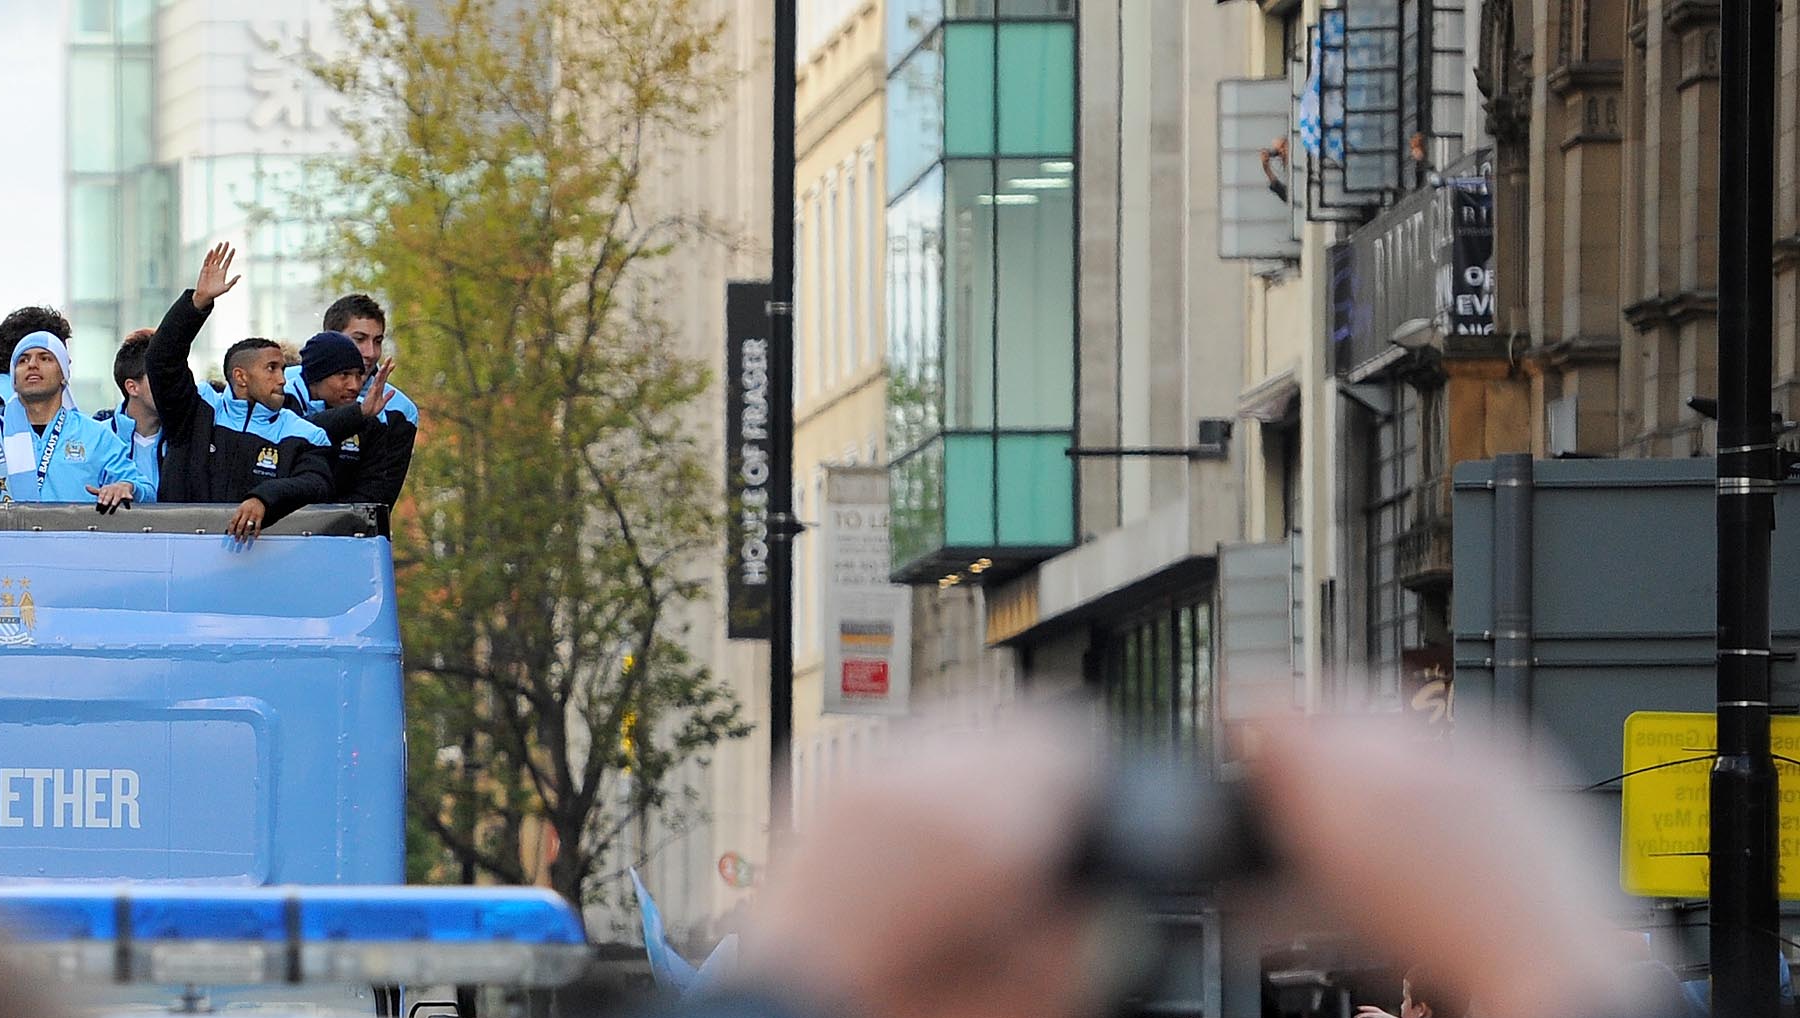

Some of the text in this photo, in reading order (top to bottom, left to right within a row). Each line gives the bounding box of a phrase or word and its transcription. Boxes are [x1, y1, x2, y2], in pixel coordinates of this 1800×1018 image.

[39, 433, 59, 473] BARCLAYS
[741, 338, 769, 585] HOUSE OF FRASER
